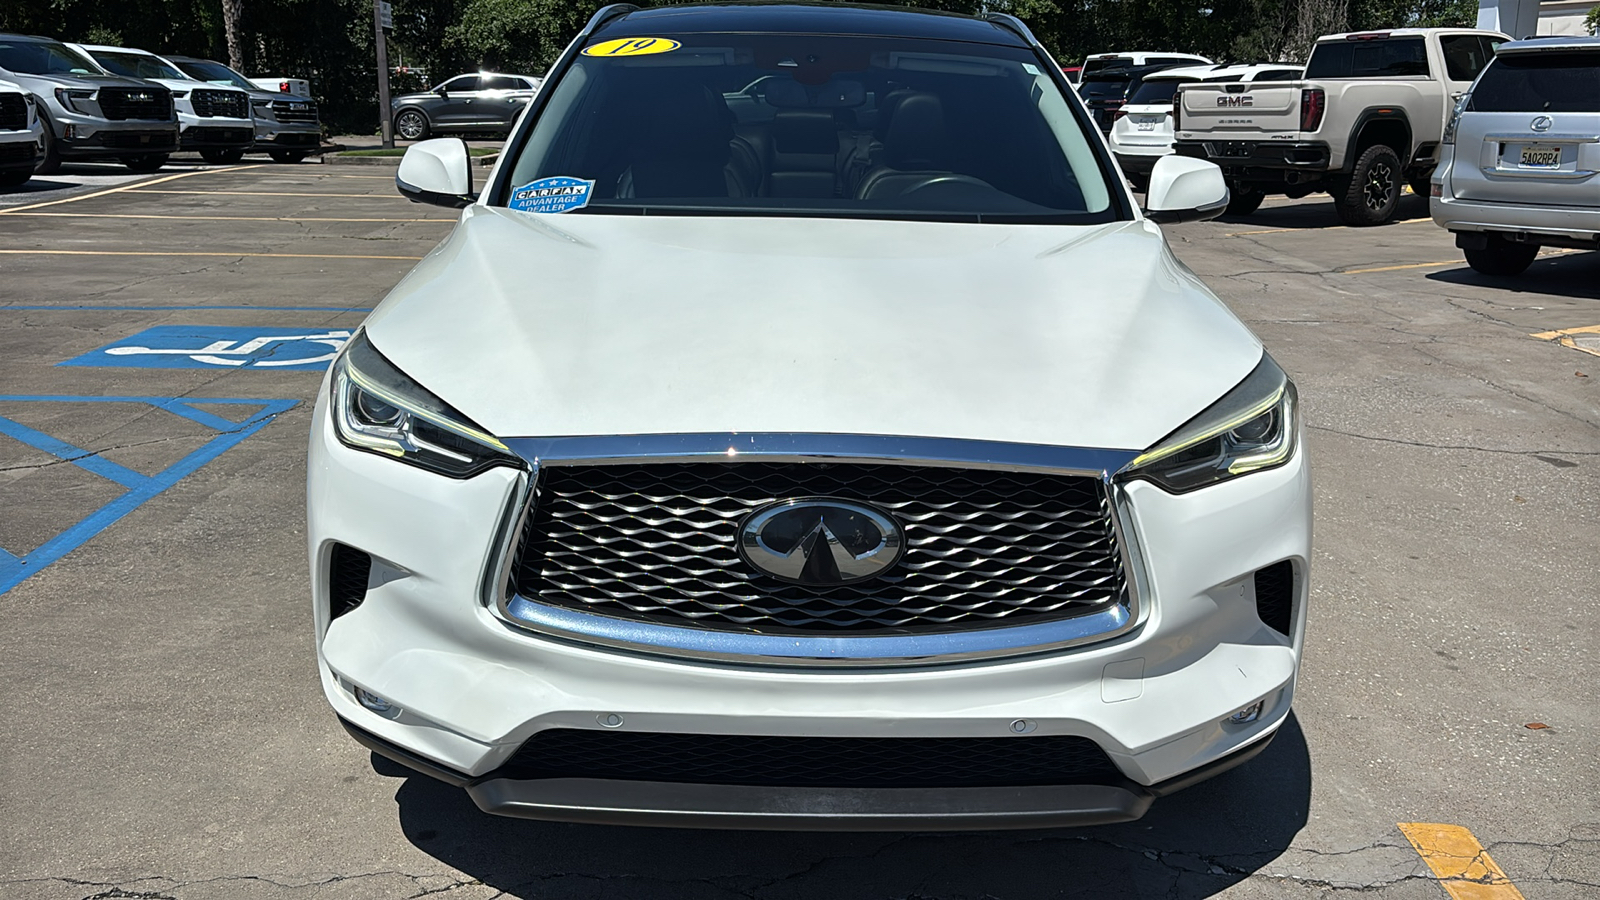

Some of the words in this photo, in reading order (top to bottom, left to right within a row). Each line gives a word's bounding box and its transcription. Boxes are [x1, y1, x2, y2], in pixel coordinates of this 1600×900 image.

[607, 38, 657, 54] 19
[1216, 96, 1253, 107] GMC
[1522, 152, 1558, 164] 5A02RP4
[516, 187, 585, 199] CARFAX
[518, 195, 578, 208] ADVANTAGE
[526, 204, 566, 213] DEALER
